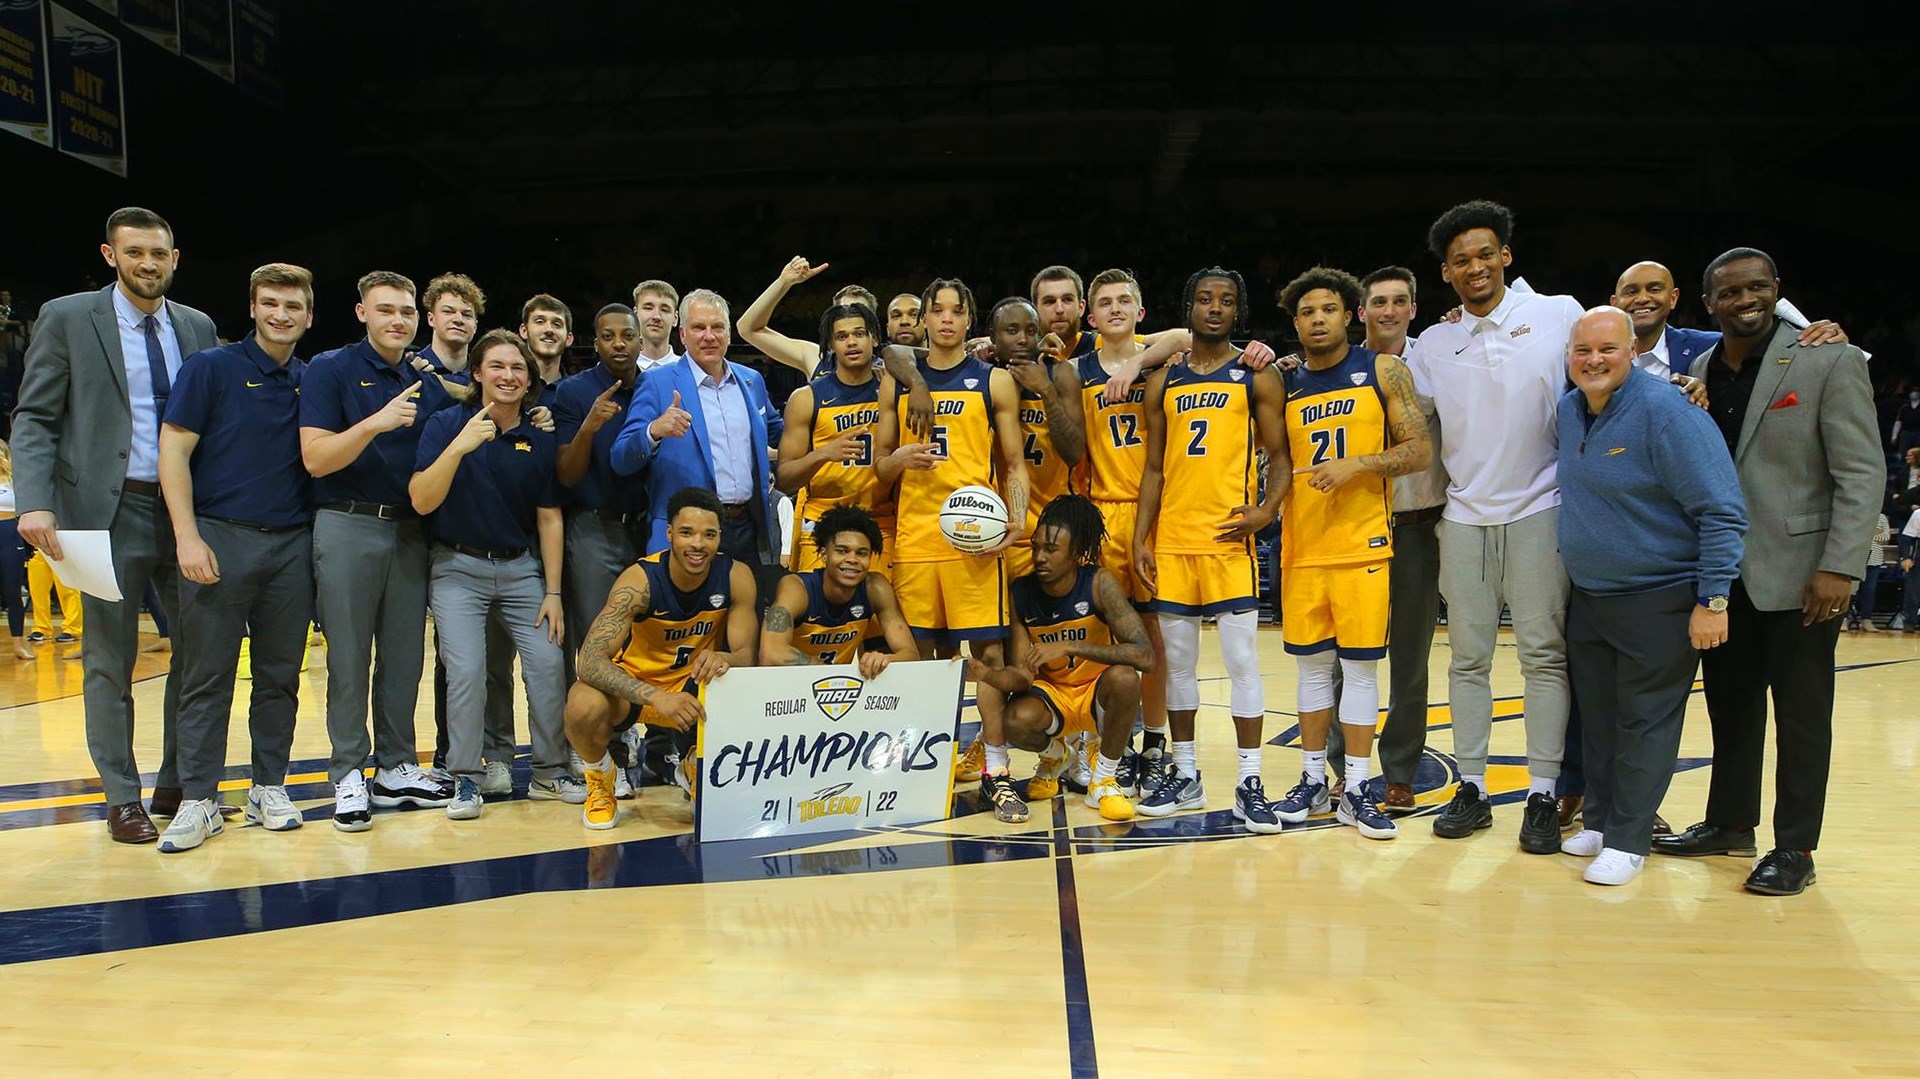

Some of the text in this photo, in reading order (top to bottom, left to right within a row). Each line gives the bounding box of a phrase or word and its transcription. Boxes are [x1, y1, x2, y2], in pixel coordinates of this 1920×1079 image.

[933, 400, 965, 416] EDO
[1175, 391, 1230, 415] TOLEDO
[1300, 398, 1356, 426] TOLEDO
[833, 409, 879, 433] TOLEDO
[1109, 413, 1143, 448] 12
[1023, 432, 1045, 467] 4
[1187, 419, 1209, 457] 2
[1310, 427, 1346, 466] 21
[949, 496, 994, 513] Wilson
[664, 620, 713, 641] TOLEDO
[810, 630, 859, 645] TOLEDO
[1037, 627, 1087, 643] TOLEDO
[765, 690, 900, 717] REGULAR MAC SEASON
[709, 730, 951, 788] CHAMPIONS
[761, 790, 898, 823] 21 TOLEDO 22
